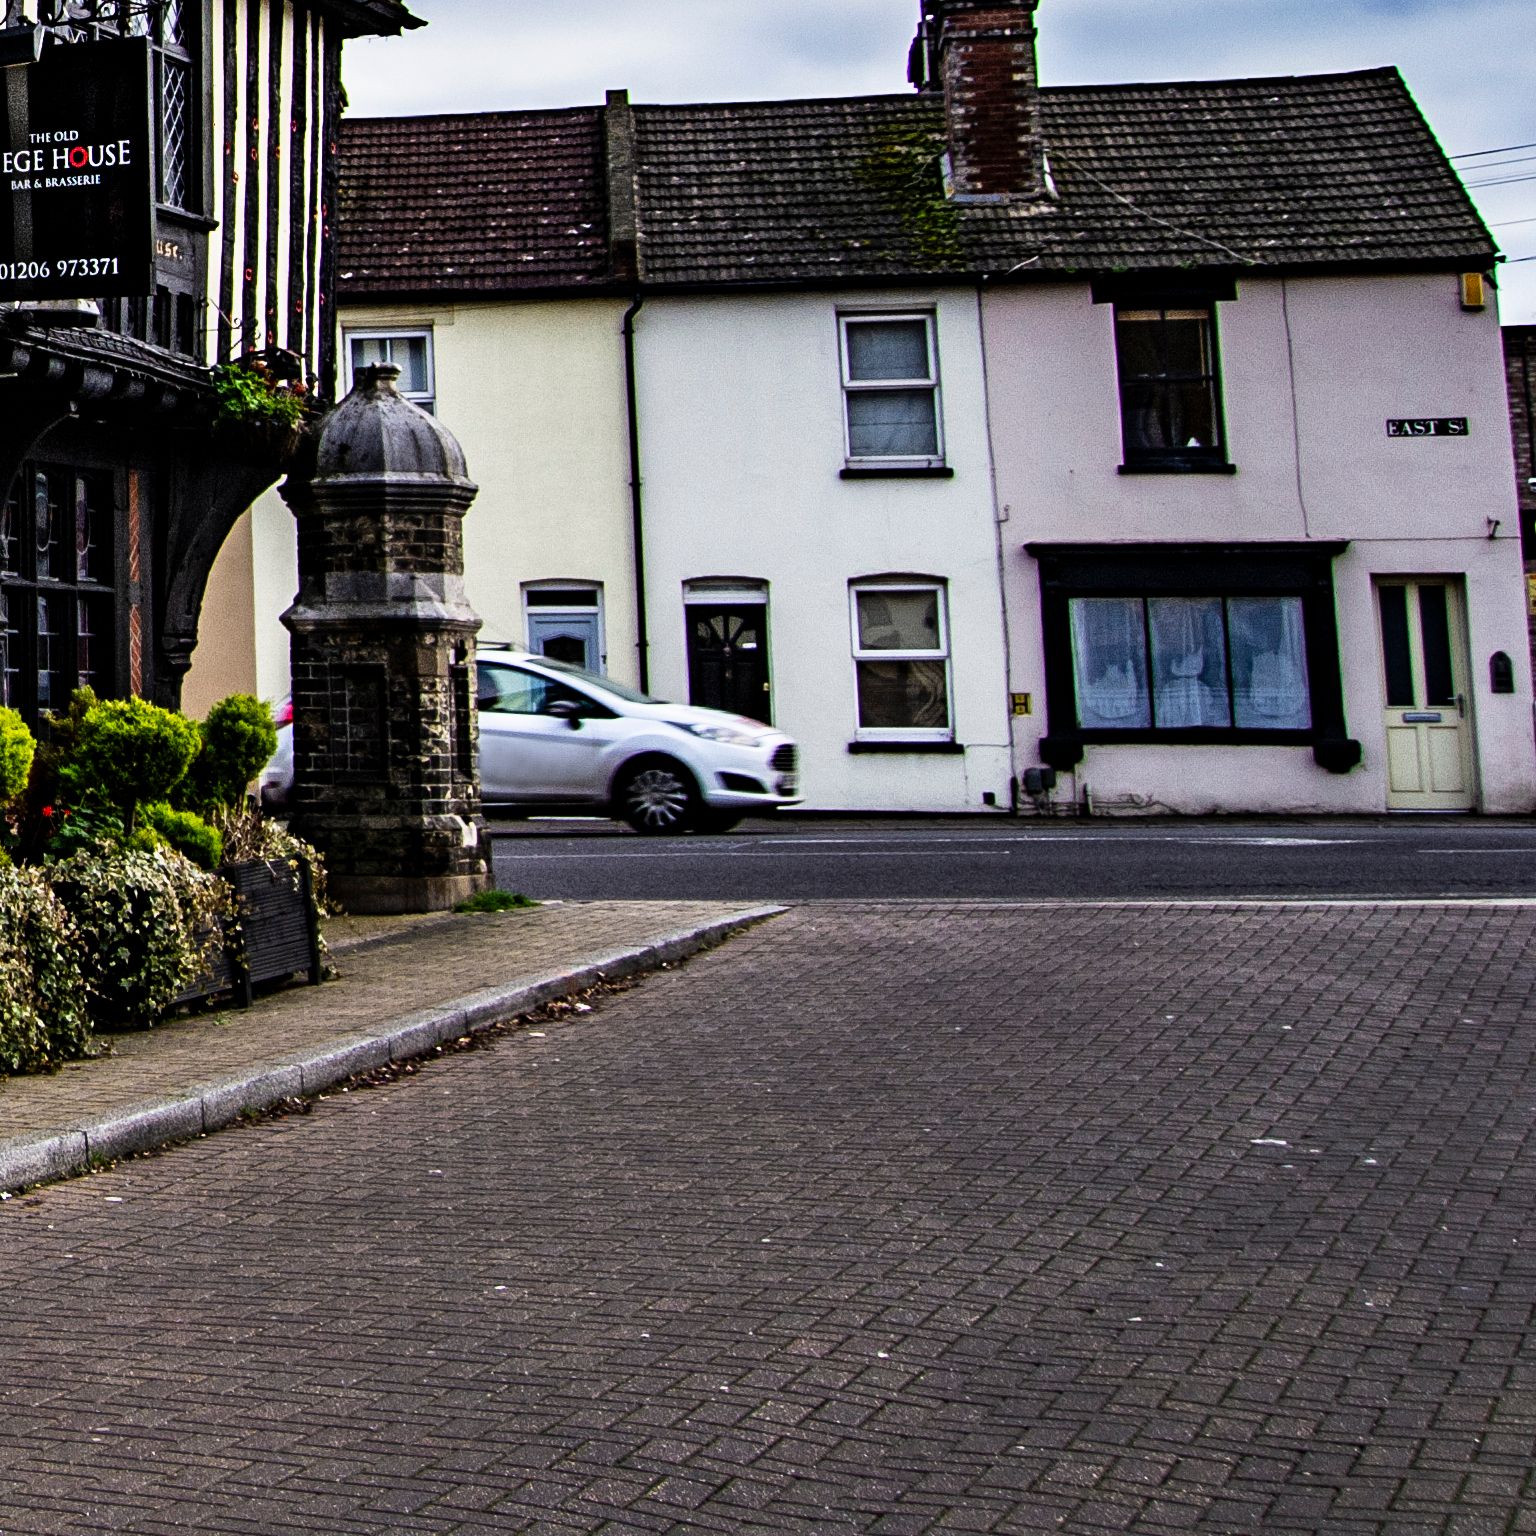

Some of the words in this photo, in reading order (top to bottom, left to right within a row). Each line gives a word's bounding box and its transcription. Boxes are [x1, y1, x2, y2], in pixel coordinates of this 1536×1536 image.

[29, 132, 51, 144] THE
[54, 130, 79, 142] OLD
[52, 139, 131, 170] HOUSE
[11, 179, 31, 190] BAR
[34, 178, 42, 189] &
[45, 174, 101, 188] BRASSERIE
[56, 257, 119, 277] 973371
[1388, 420, 1438, 435] EAST
